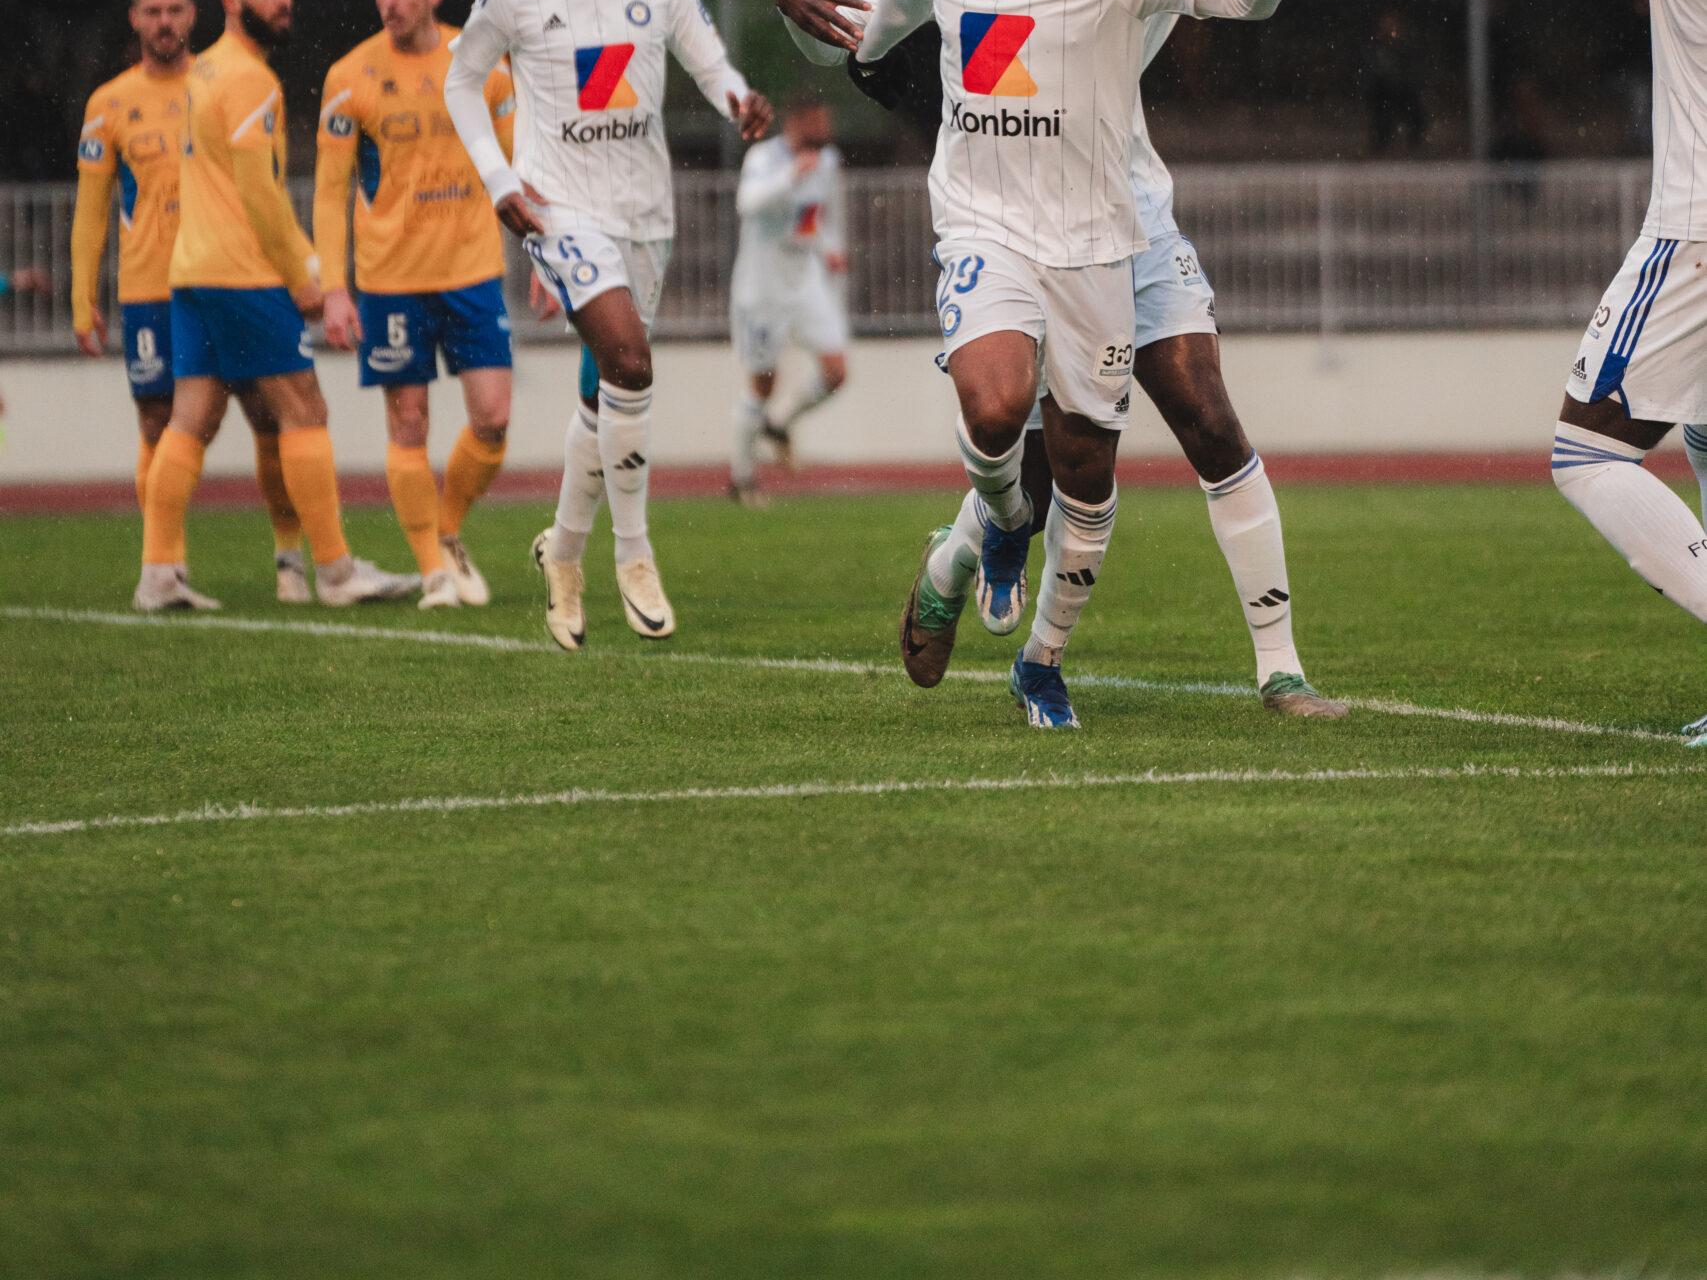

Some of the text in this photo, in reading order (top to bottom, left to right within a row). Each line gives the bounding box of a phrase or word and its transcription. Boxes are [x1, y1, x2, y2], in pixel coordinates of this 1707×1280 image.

[332, 119, 350, 135] N
[950, 100, 1060, 137] Konbini
[85, 140, 99, 158] N
[387, 312, 407, 348] 5
[1102, 343, 1132, 367] 360
